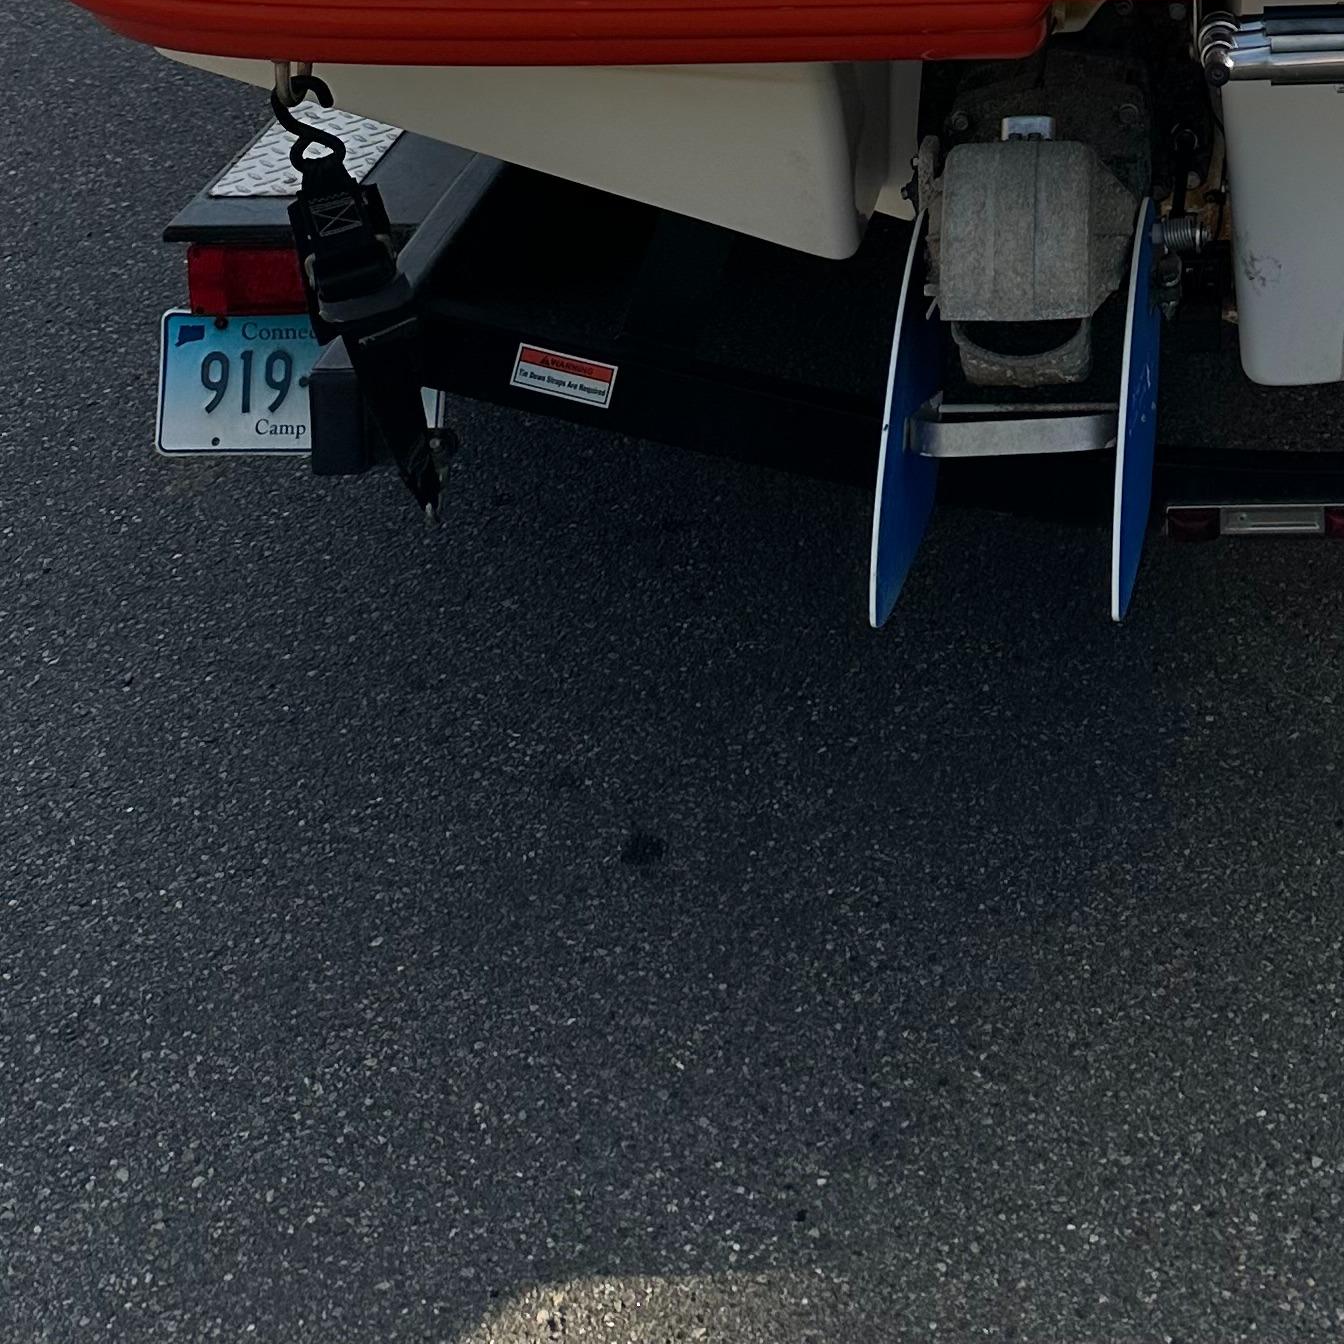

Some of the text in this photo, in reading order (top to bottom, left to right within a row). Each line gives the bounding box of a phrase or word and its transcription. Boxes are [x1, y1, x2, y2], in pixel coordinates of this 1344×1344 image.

[551, 357, 594, 375] WARNING
[201, 349, 293, 414] 919
[255, 418, 306, 439] Camp
